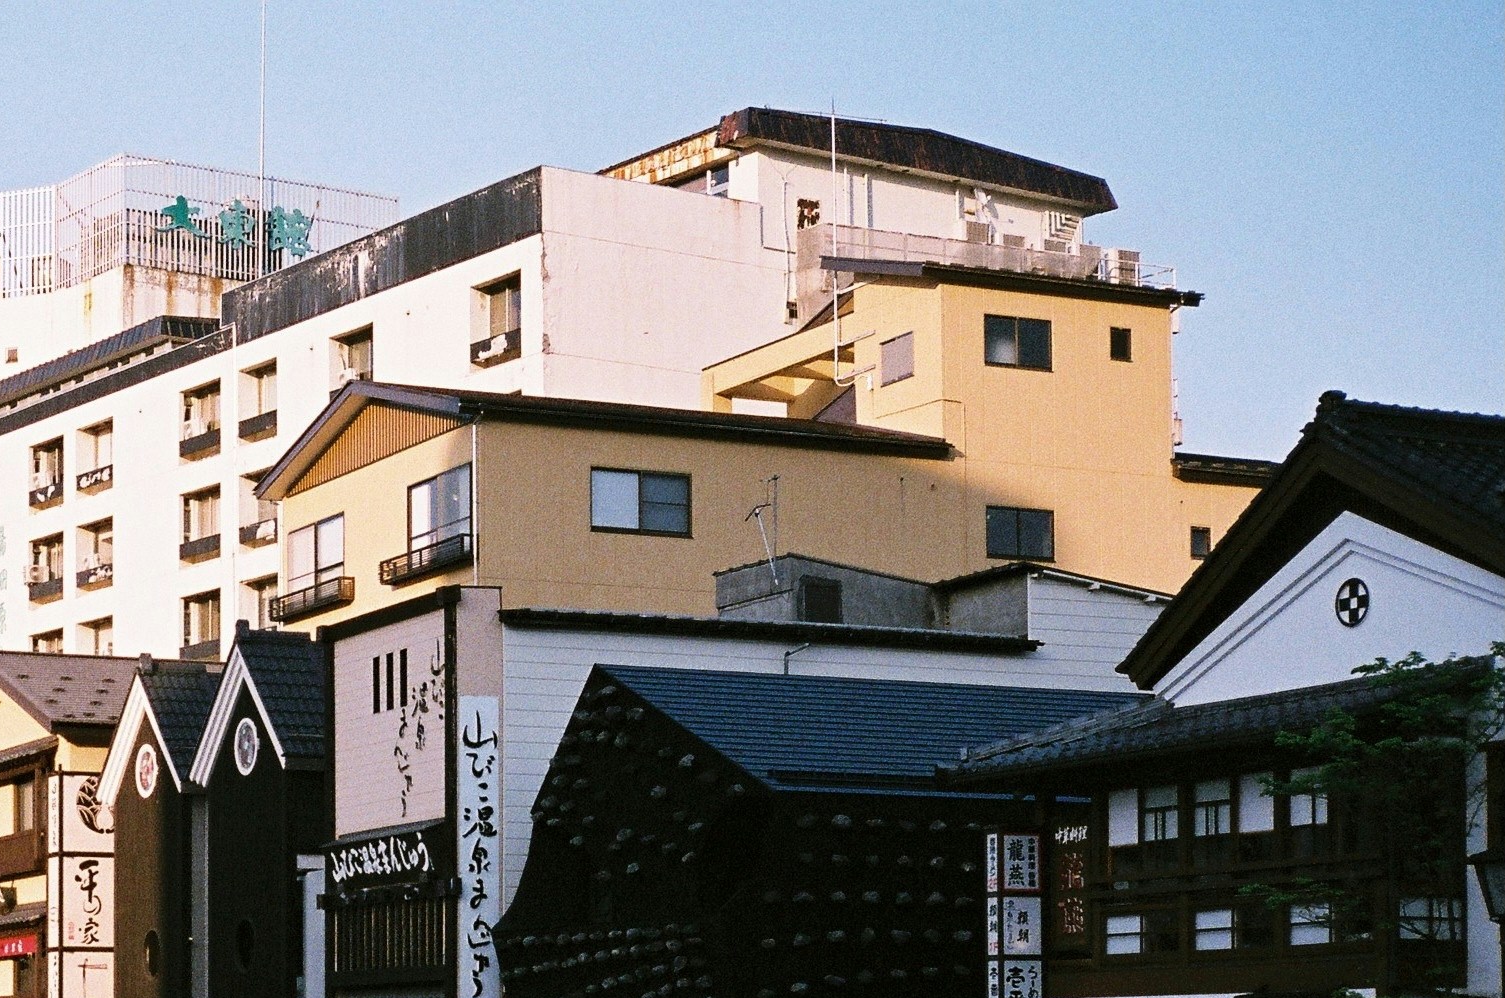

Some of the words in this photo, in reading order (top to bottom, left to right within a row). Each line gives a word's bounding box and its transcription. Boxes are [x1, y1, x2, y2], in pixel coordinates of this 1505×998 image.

[155, 194, 315, 257] 大東館
[411, 681, 429, 751] 温泉
